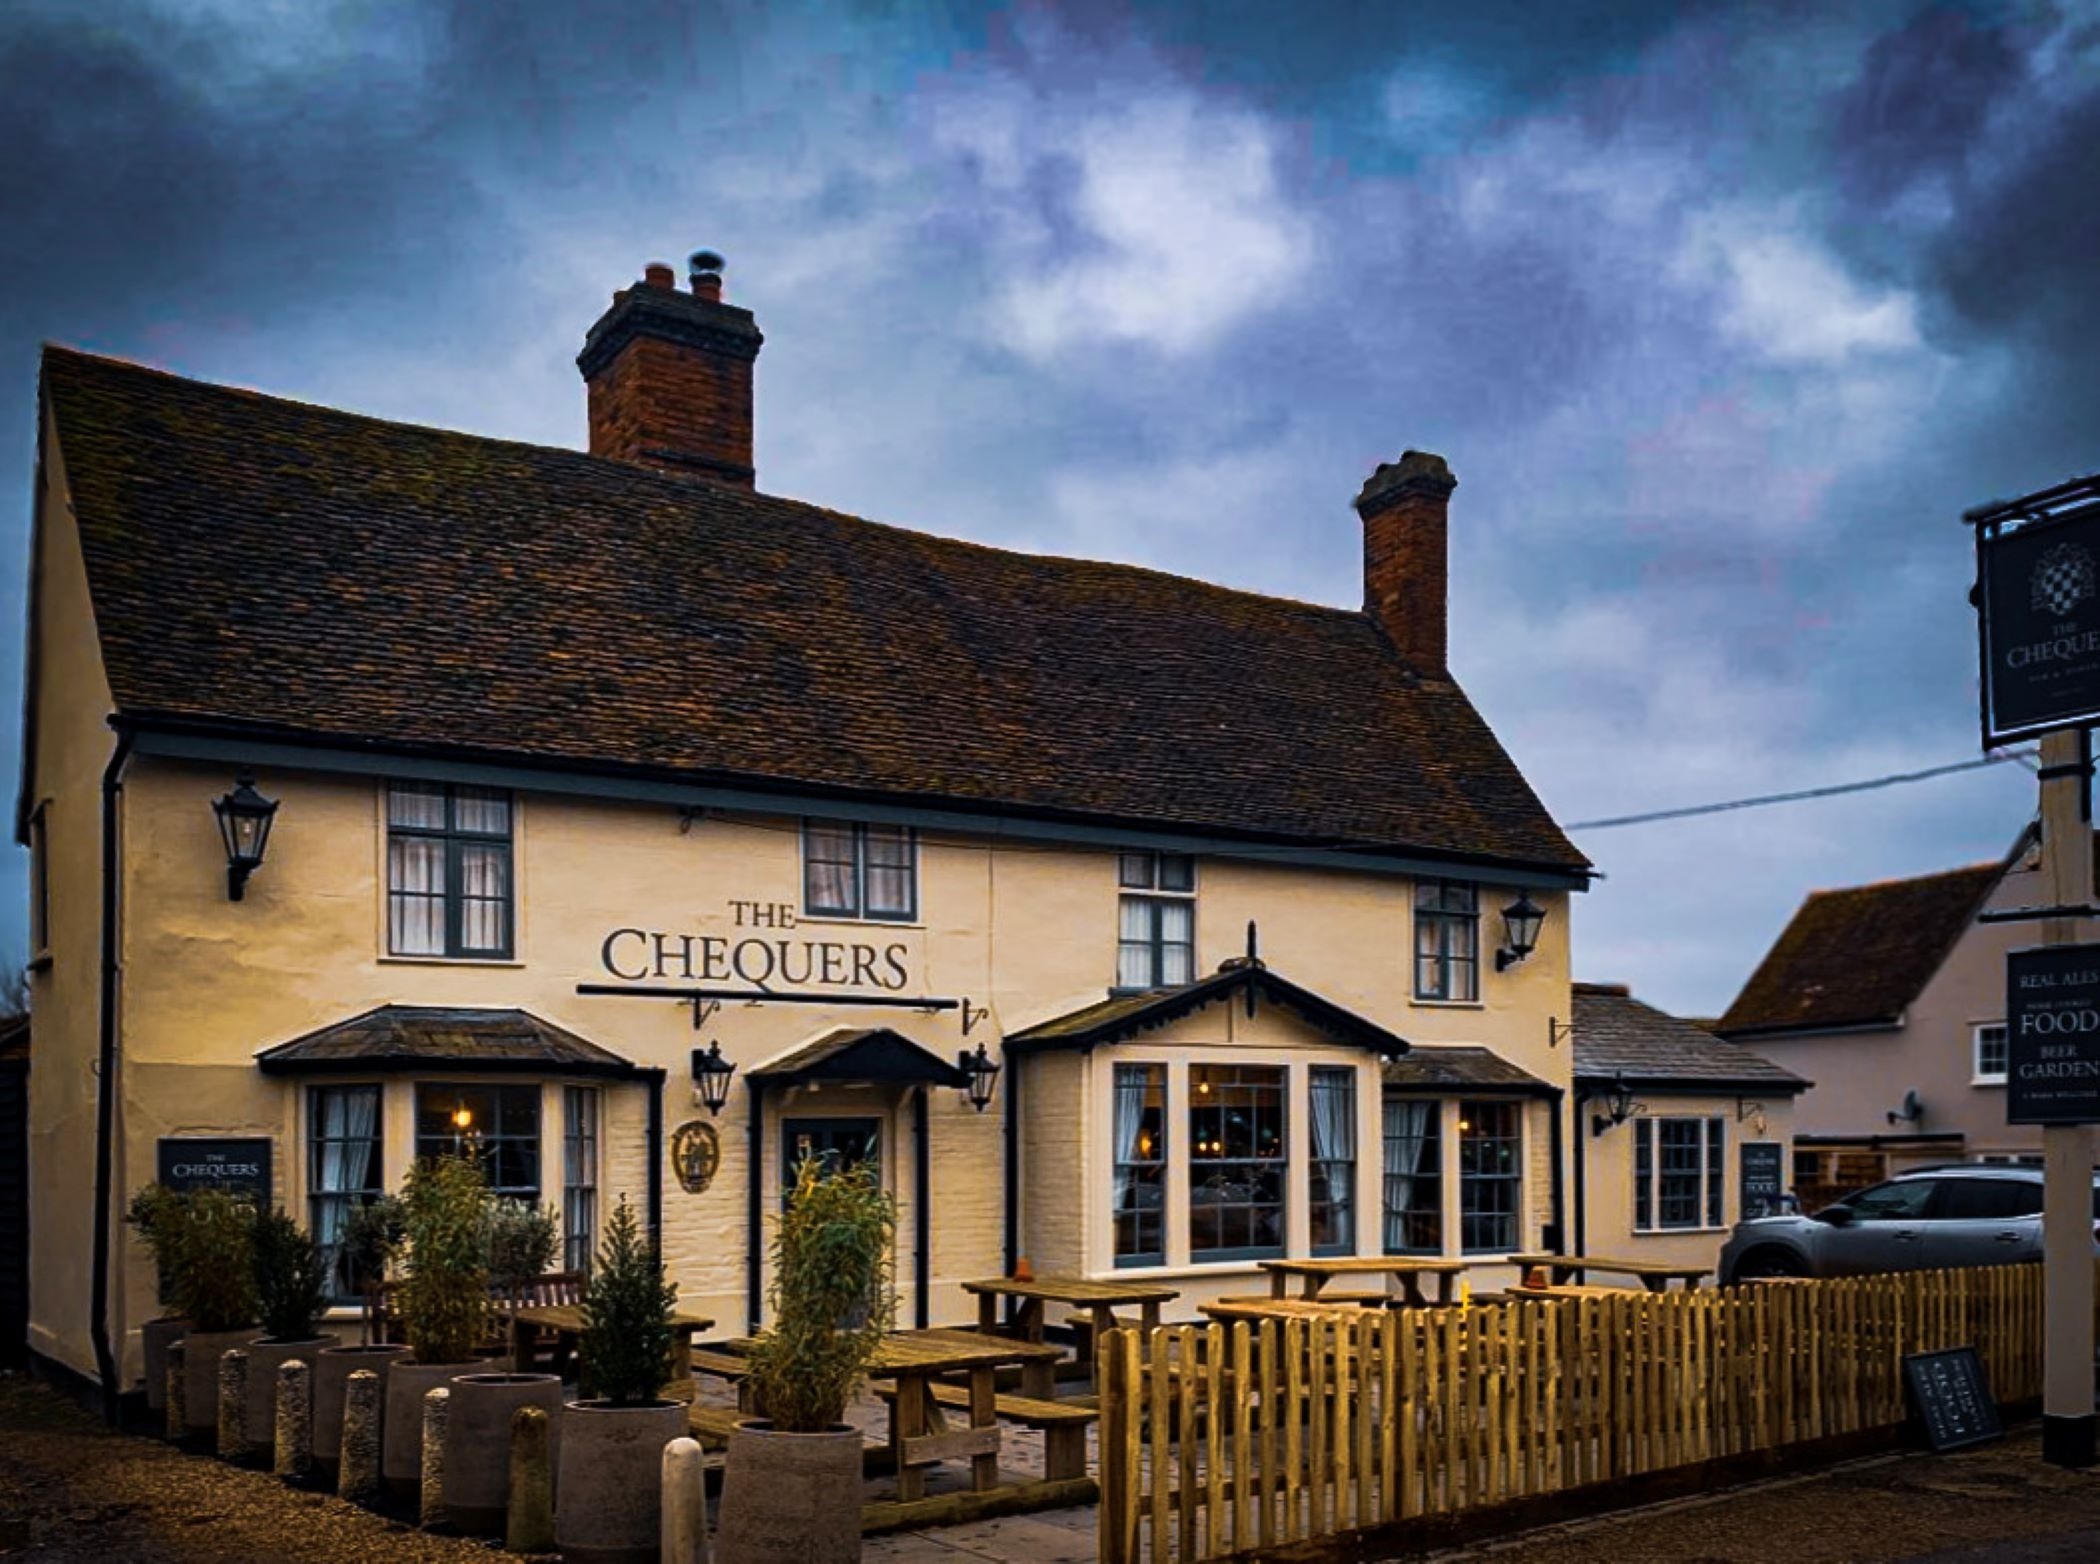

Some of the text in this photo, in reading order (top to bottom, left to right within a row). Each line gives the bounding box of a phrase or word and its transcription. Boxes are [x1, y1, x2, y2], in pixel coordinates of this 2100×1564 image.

[728, 900, 796, 930] THE
[601, 928, 908, 994] CHEQUERS
[2019, 970, 2099, 989] REAL ALES
[2020, 1009, 2099, 1036] FOOD
[2040, 1043, 2078, 1060] BEER
[2018, 1059, 2100, 1080] GARDEN
[172, 1163, 260, 1178] CHEQUERS
